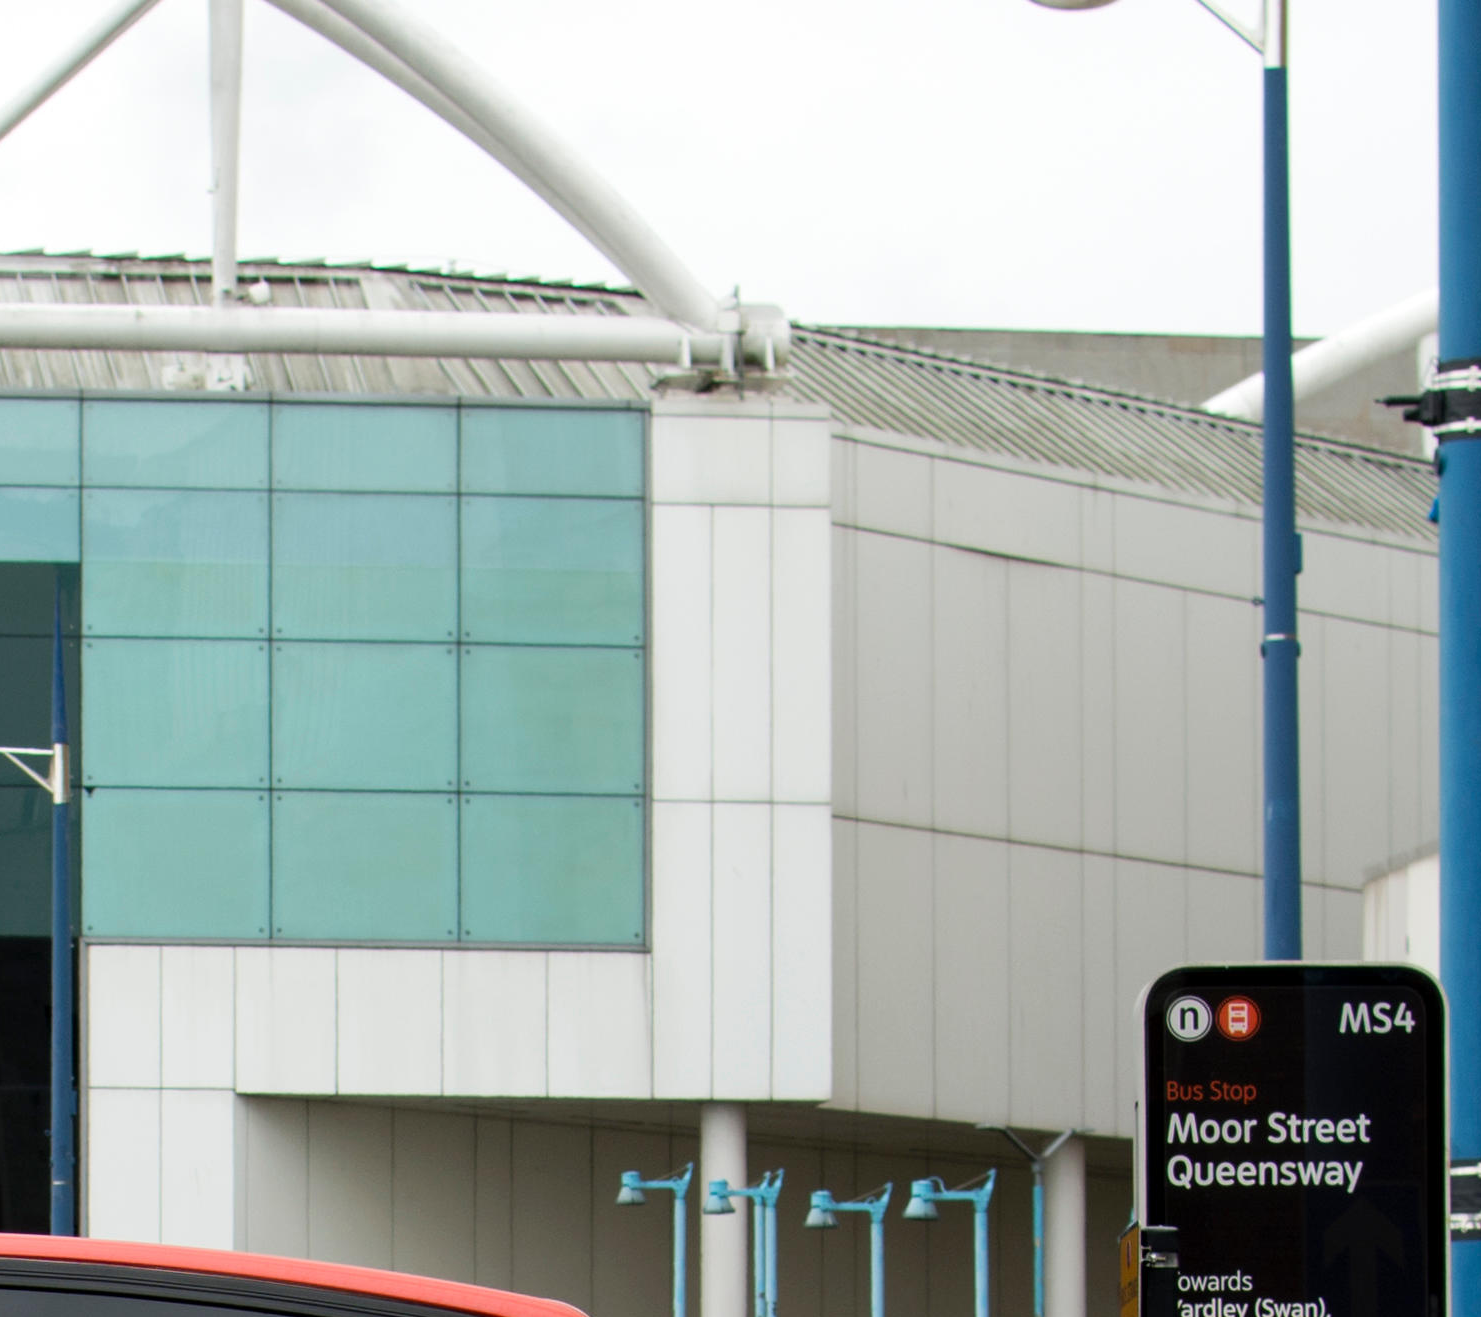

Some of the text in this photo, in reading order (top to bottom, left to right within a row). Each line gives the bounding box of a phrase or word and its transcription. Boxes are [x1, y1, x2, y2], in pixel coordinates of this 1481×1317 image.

[1339, 1002, 1416, 1034] MS4
[1166, 1080, 1257, 1104] Bus Stop
[1167, 1111, 1371, 1144] Moor Street
[1167, 1154, 1363, 1194] Queensway
[1177, 1270, 1253, 1292] owards
